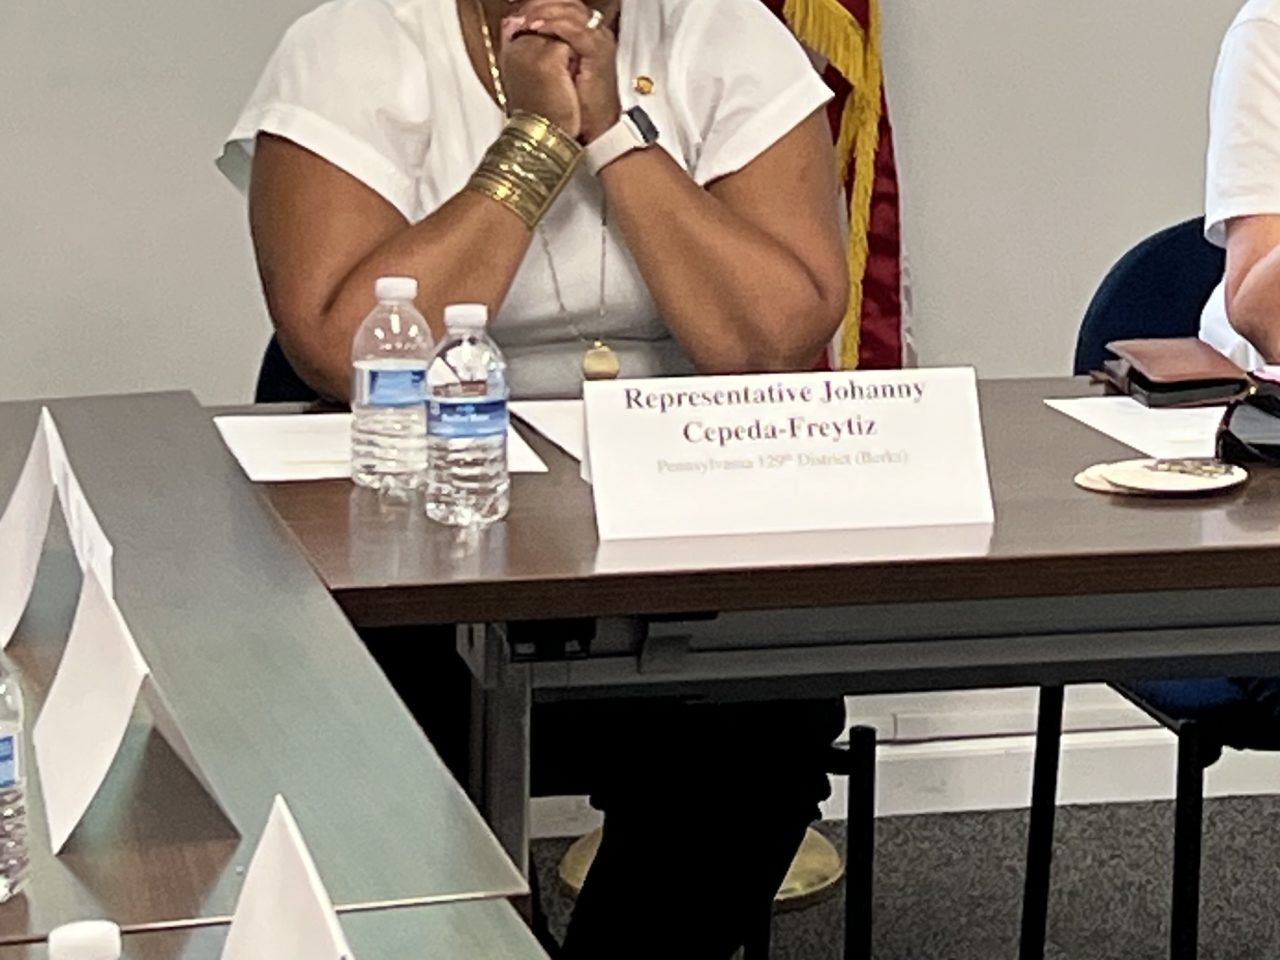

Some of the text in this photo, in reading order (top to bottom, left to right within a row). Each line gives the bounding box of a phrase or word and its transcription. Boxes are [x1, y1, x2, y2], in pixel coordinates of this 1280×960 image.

[624, 380, 926, 414] Representative Johanny
[683, 416, 878, 446] Cepeda-Freytiz
[657, 457, 753, 474] Pennsylvania
[797, 452, 852, 467] District
[855, 450, 908, 466] (Berks)
